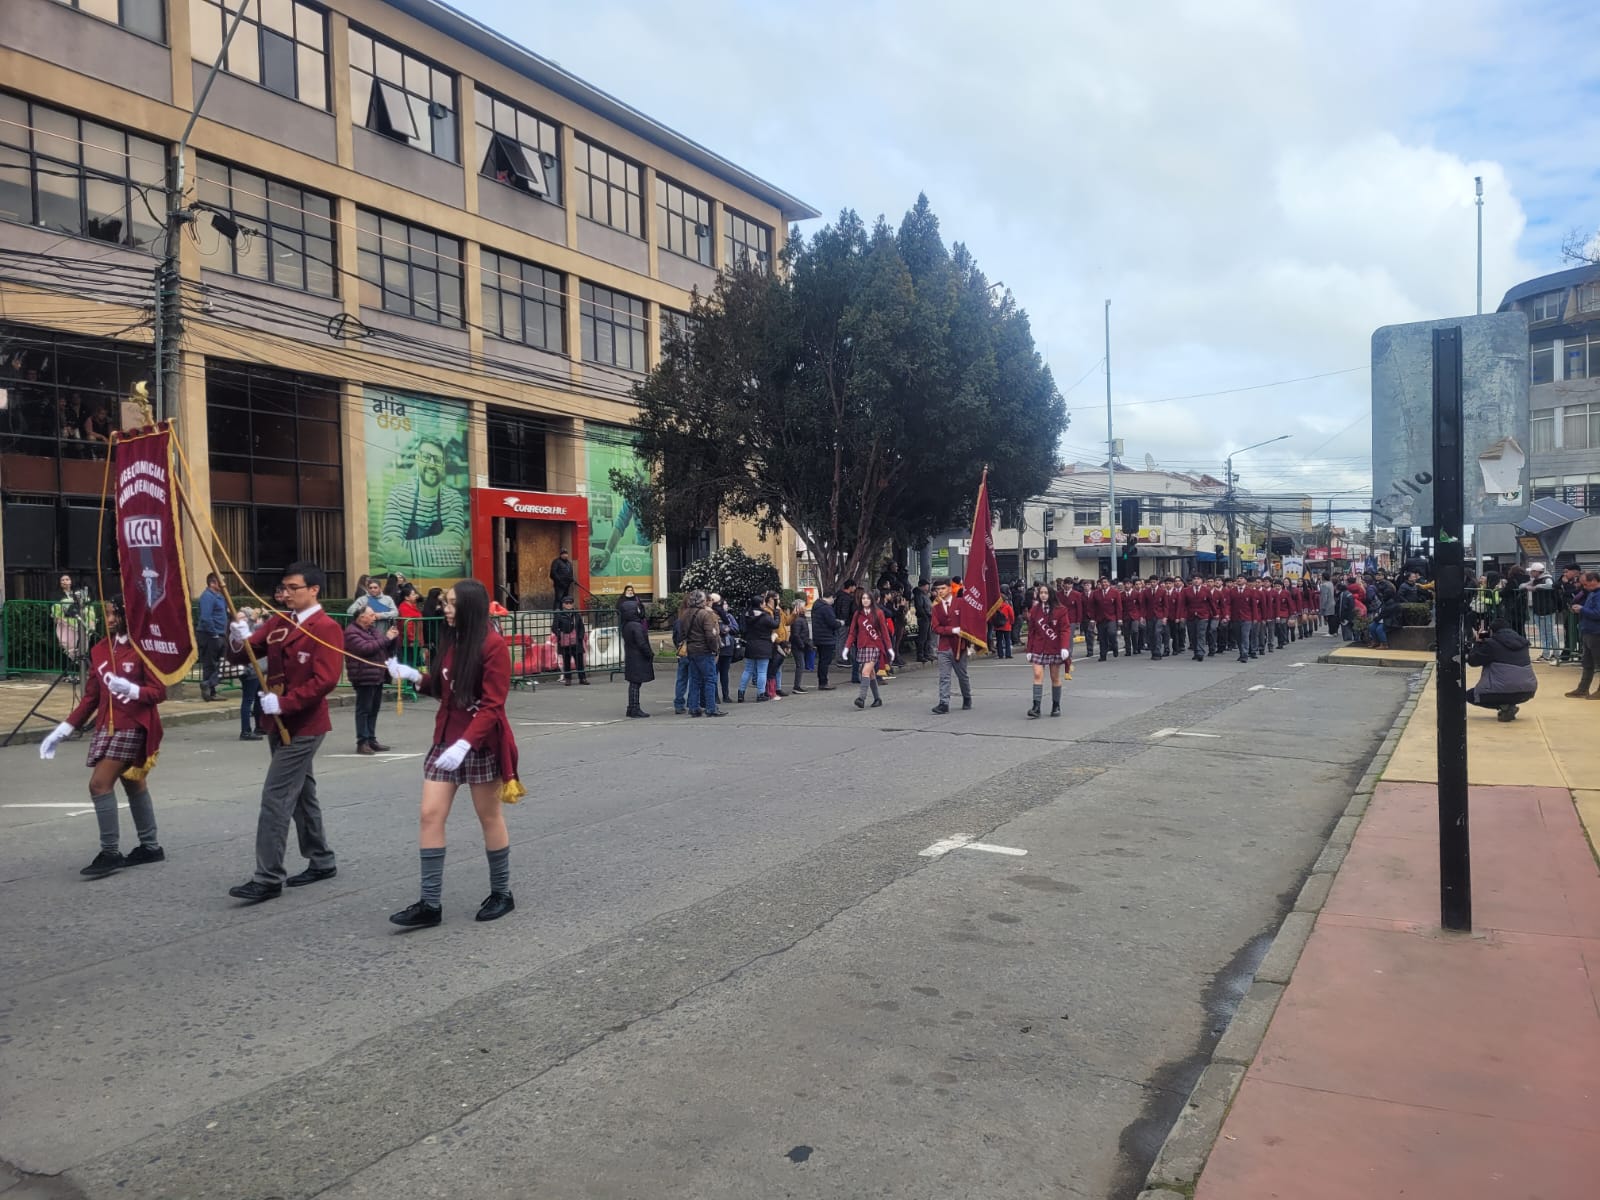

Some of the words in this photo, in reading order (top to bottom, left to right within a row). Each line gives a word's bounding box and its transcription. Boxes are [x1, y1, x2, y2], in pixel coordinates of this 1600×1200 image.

[373, 395, 405, 417] alia
[377, 411, 411, 432] dos
[128, 520, 160, 545] LCCH
[862, 618, 879, 640] LCCH
[1038, 617, 1057, 640] LCCH
